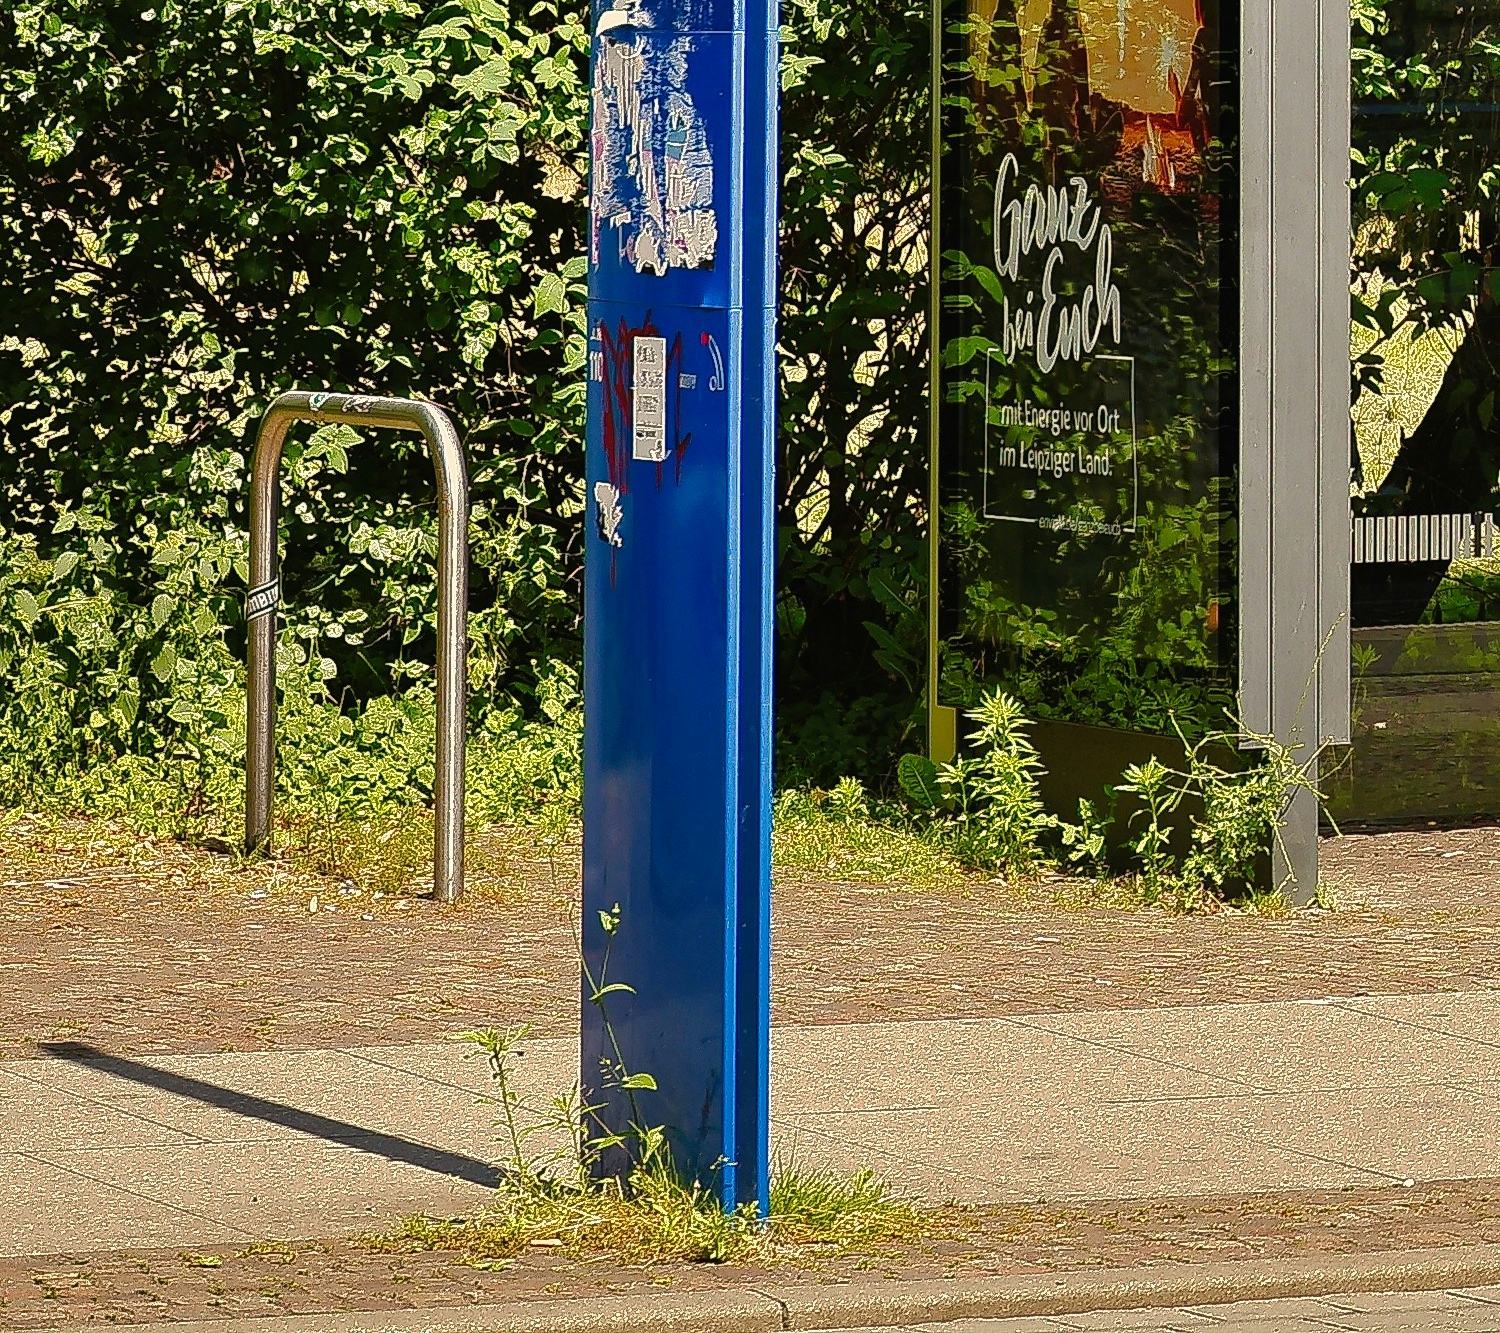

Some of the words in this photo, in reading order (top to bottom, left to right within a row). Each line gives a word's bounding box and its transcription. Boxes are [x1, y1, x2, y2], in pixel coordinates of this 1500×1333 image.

[994, 152, 1101, 282] Ganz
[1003, 290, 1034, 364] bei
[1036, 223, 1121, 374] Euch
[1000, 438, 1016, 467] im
[1020, 440, 1076, 478] Leipziger
[1078, 446, 1113, 476] Land.
[1001, 398, 1023, 426] mit
[1025, 399, 1071, 436] Energie
[1073, 410, 1094, 432] vor
[1097, 404, 1120, 434] Ort
